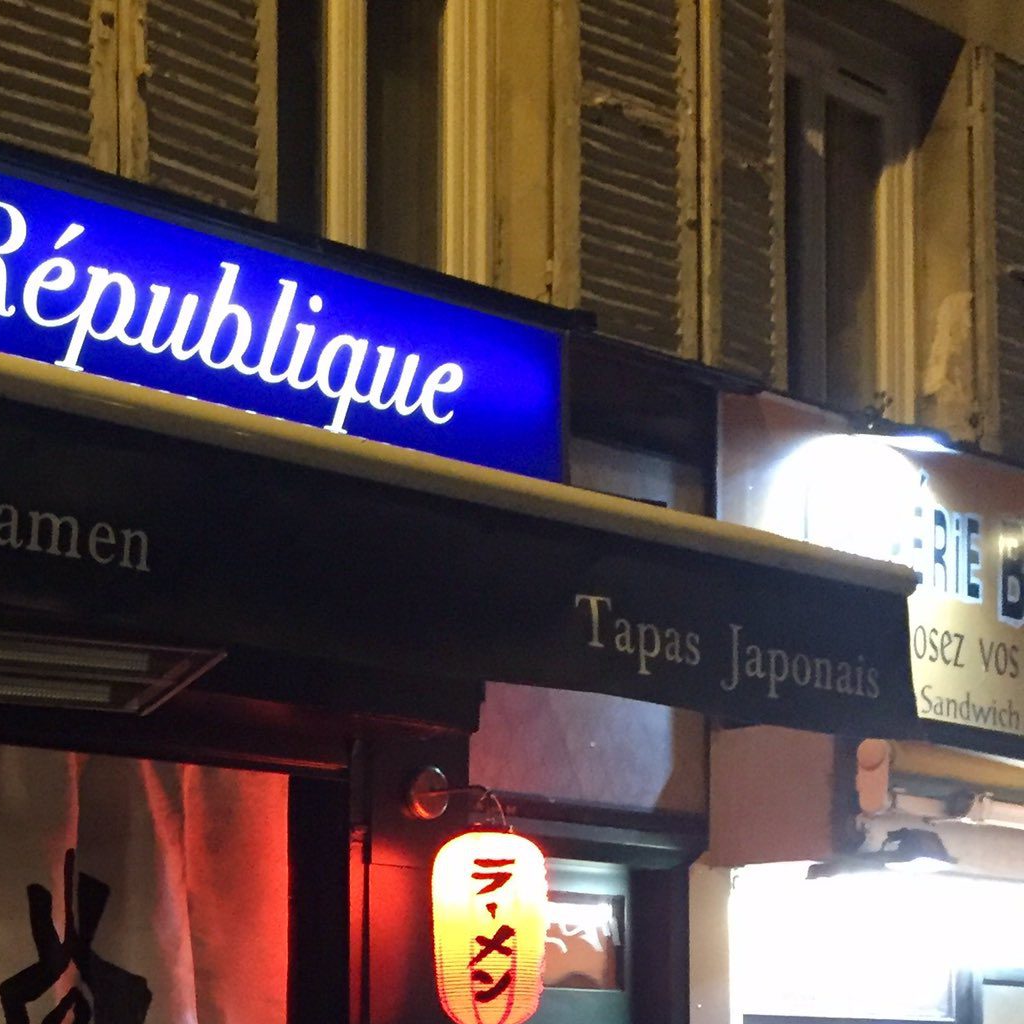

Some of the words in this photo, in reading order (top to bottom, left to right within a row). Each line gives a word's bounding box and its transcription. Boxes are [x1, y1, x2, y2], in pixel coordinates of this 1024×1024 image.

[574, 593, 702, 676] Tapas
[720, 623, 881, 699] Japonais
[978, 637, 1021, 680] vos
[466, 857, 517, 1004] ラーメン
